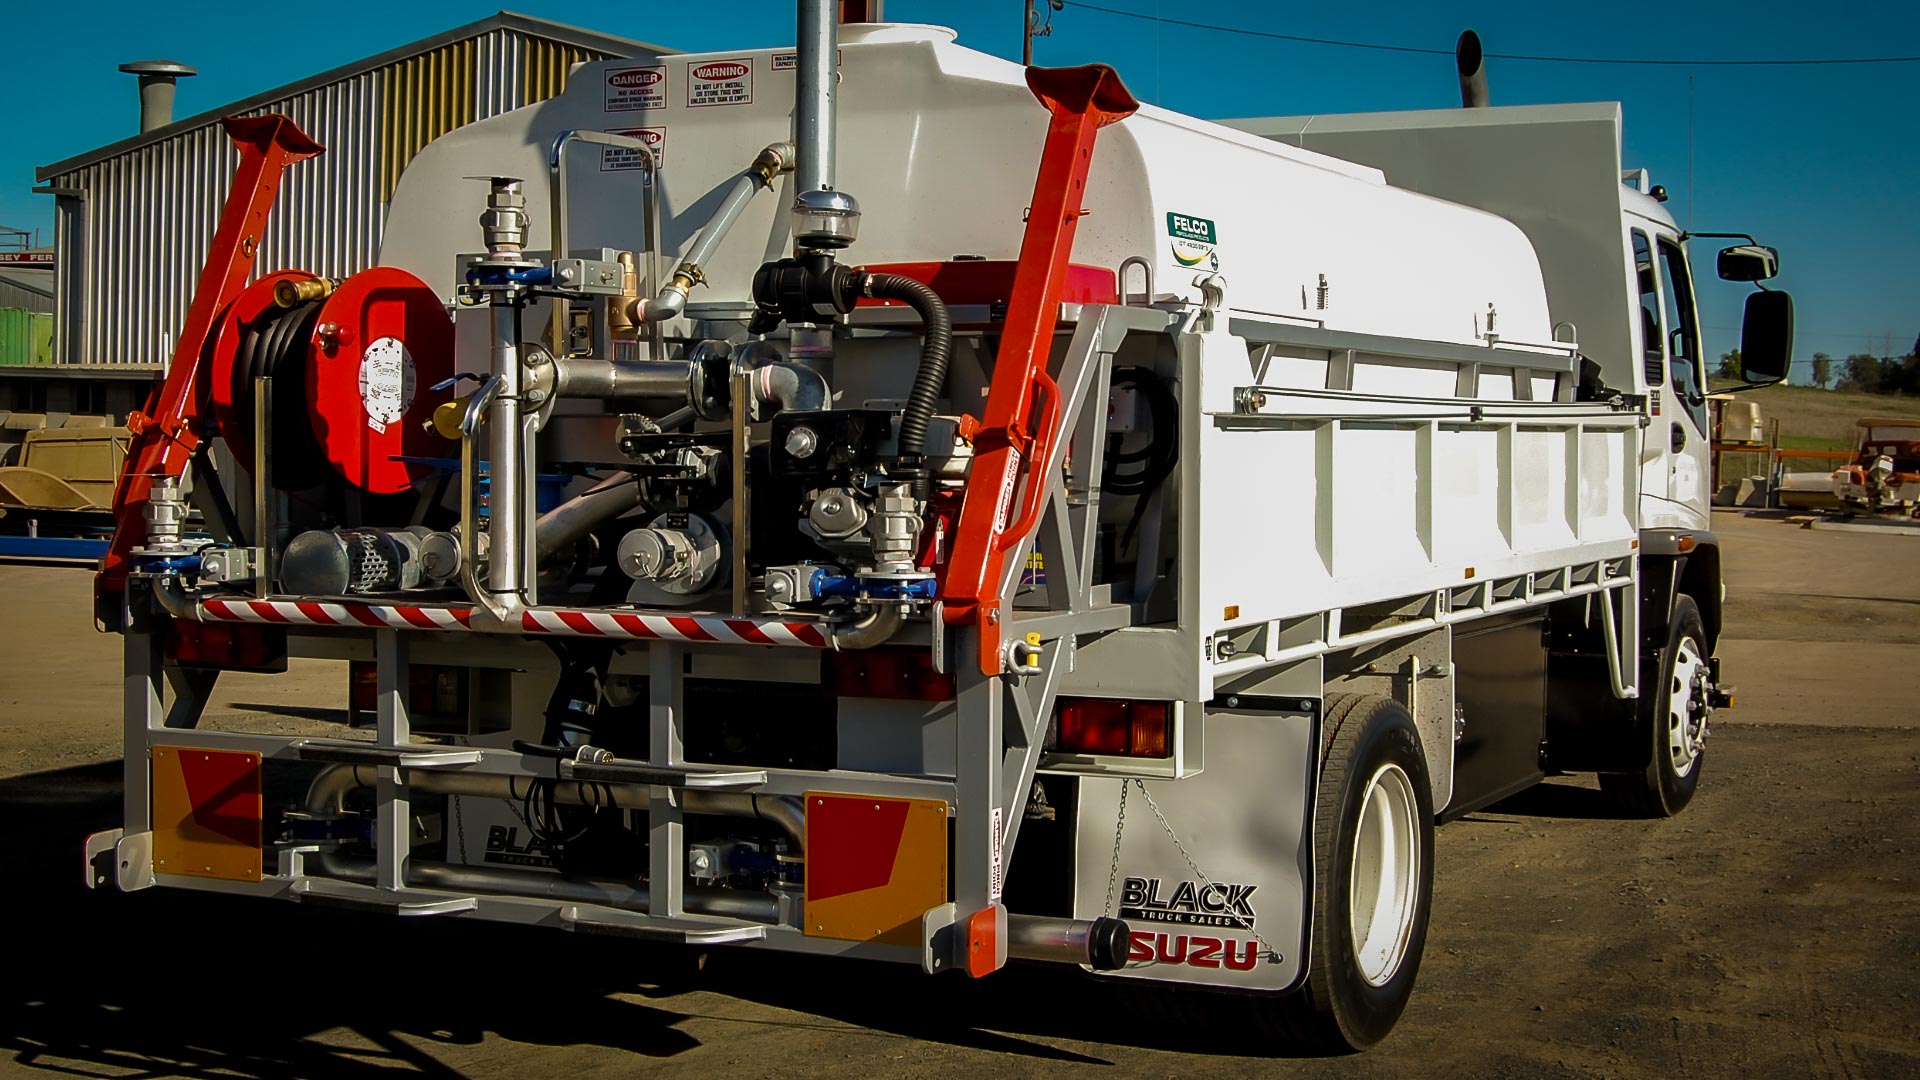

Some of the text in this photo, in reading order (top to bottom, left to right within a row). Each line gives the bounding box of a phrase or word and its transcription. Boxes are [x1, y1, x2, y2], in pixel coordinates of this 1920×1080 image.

[612, 73, 658, 85] DANGER
[696, 66, 744, 78] WARNING
[1173, 215, 1208, 235] FELCO
[486, 825, 547, 855] BLA
[502, 856, 535, 865] TRUCK
[1120, 877, 1258, 916] BLACK
[1141, 910, 1232, 926] TRUCK SALES
[1129, 930, 1258, 972] SUZU
